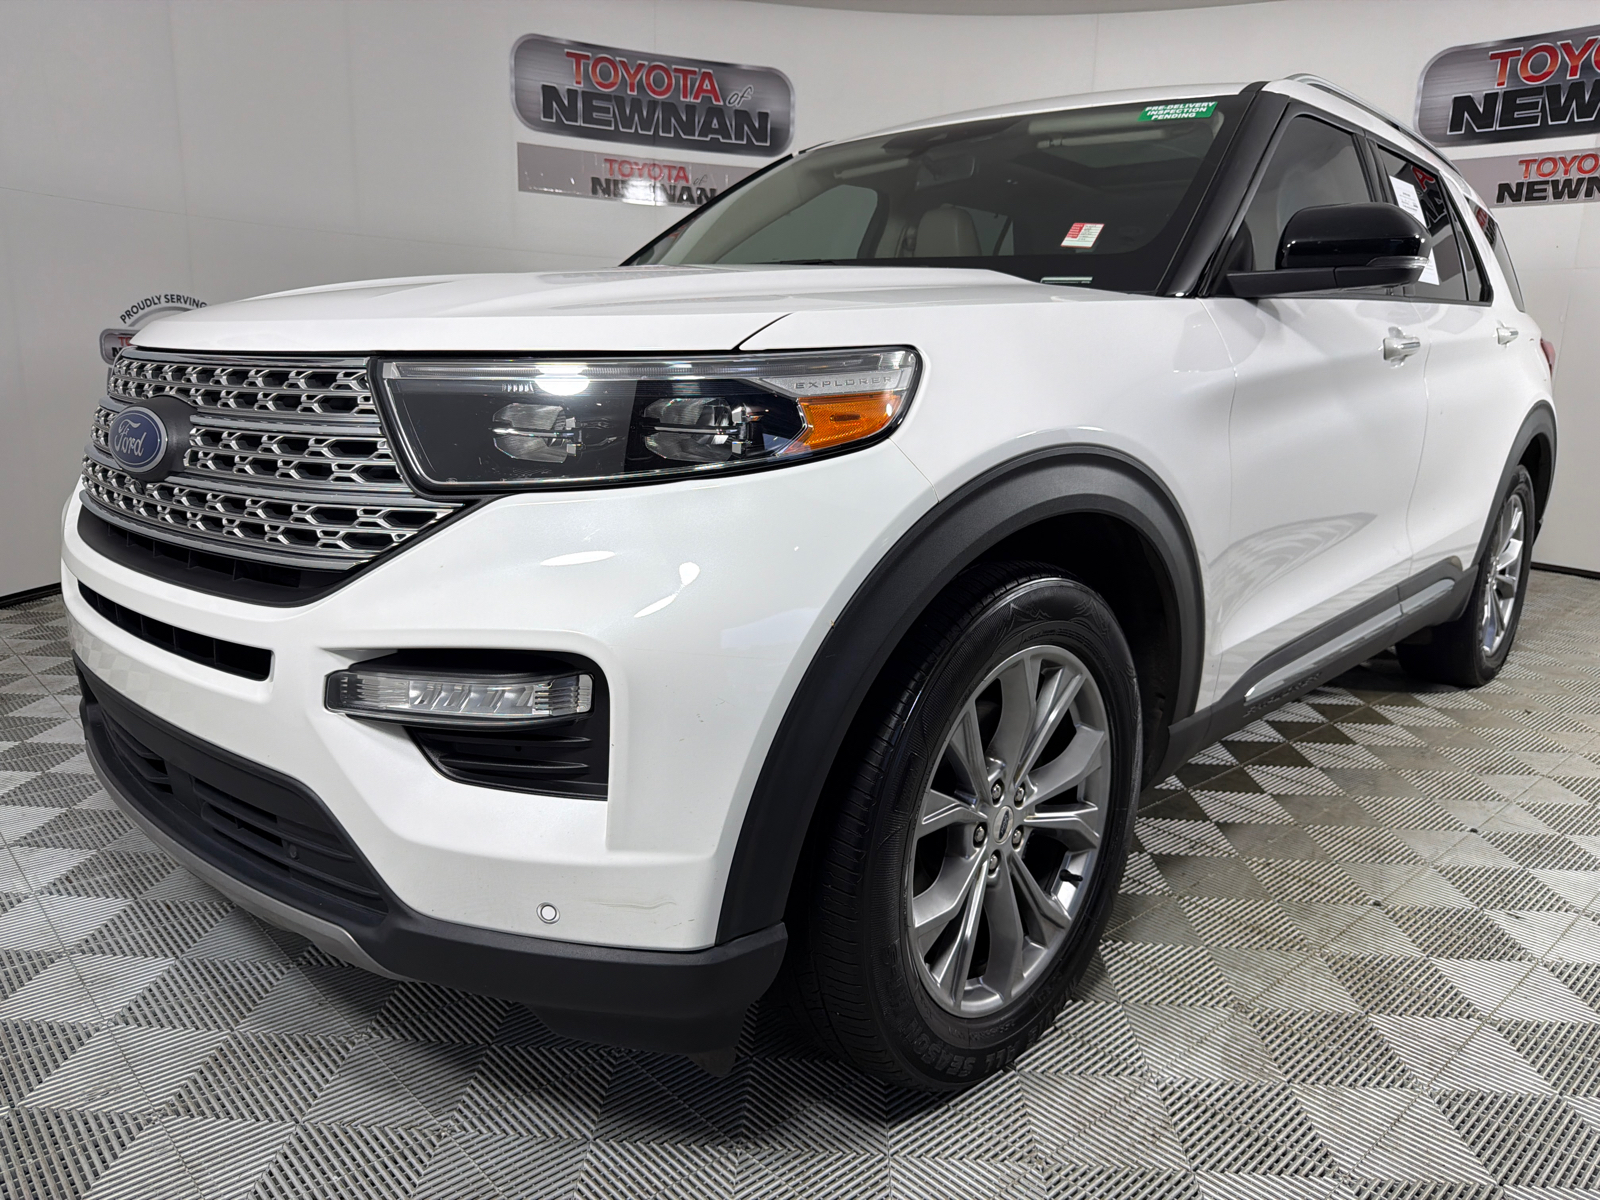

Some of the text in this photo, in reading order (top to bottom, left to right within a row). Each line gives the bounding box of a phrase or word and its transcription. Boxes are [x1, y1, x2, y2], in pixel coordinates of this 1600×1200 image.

[1489, 36, 1600, 88] TOY
[565, 49, 754, 108] TOYOTA of
[541, 84, 770, 146] NEWNAN
[1145, 101, 1215, 111] PRE-DELIVERY
[1146, 107, 1208, 116] INSPECTION
[1151, 112, 1197, 120] PENDING
[604, 158, 690, 184] TOYOTA
[120, 294, 163, 324] PROUDLY
[794, 376, 893, 390] EXPLORER
[114, 418, 148, 457] Ford
